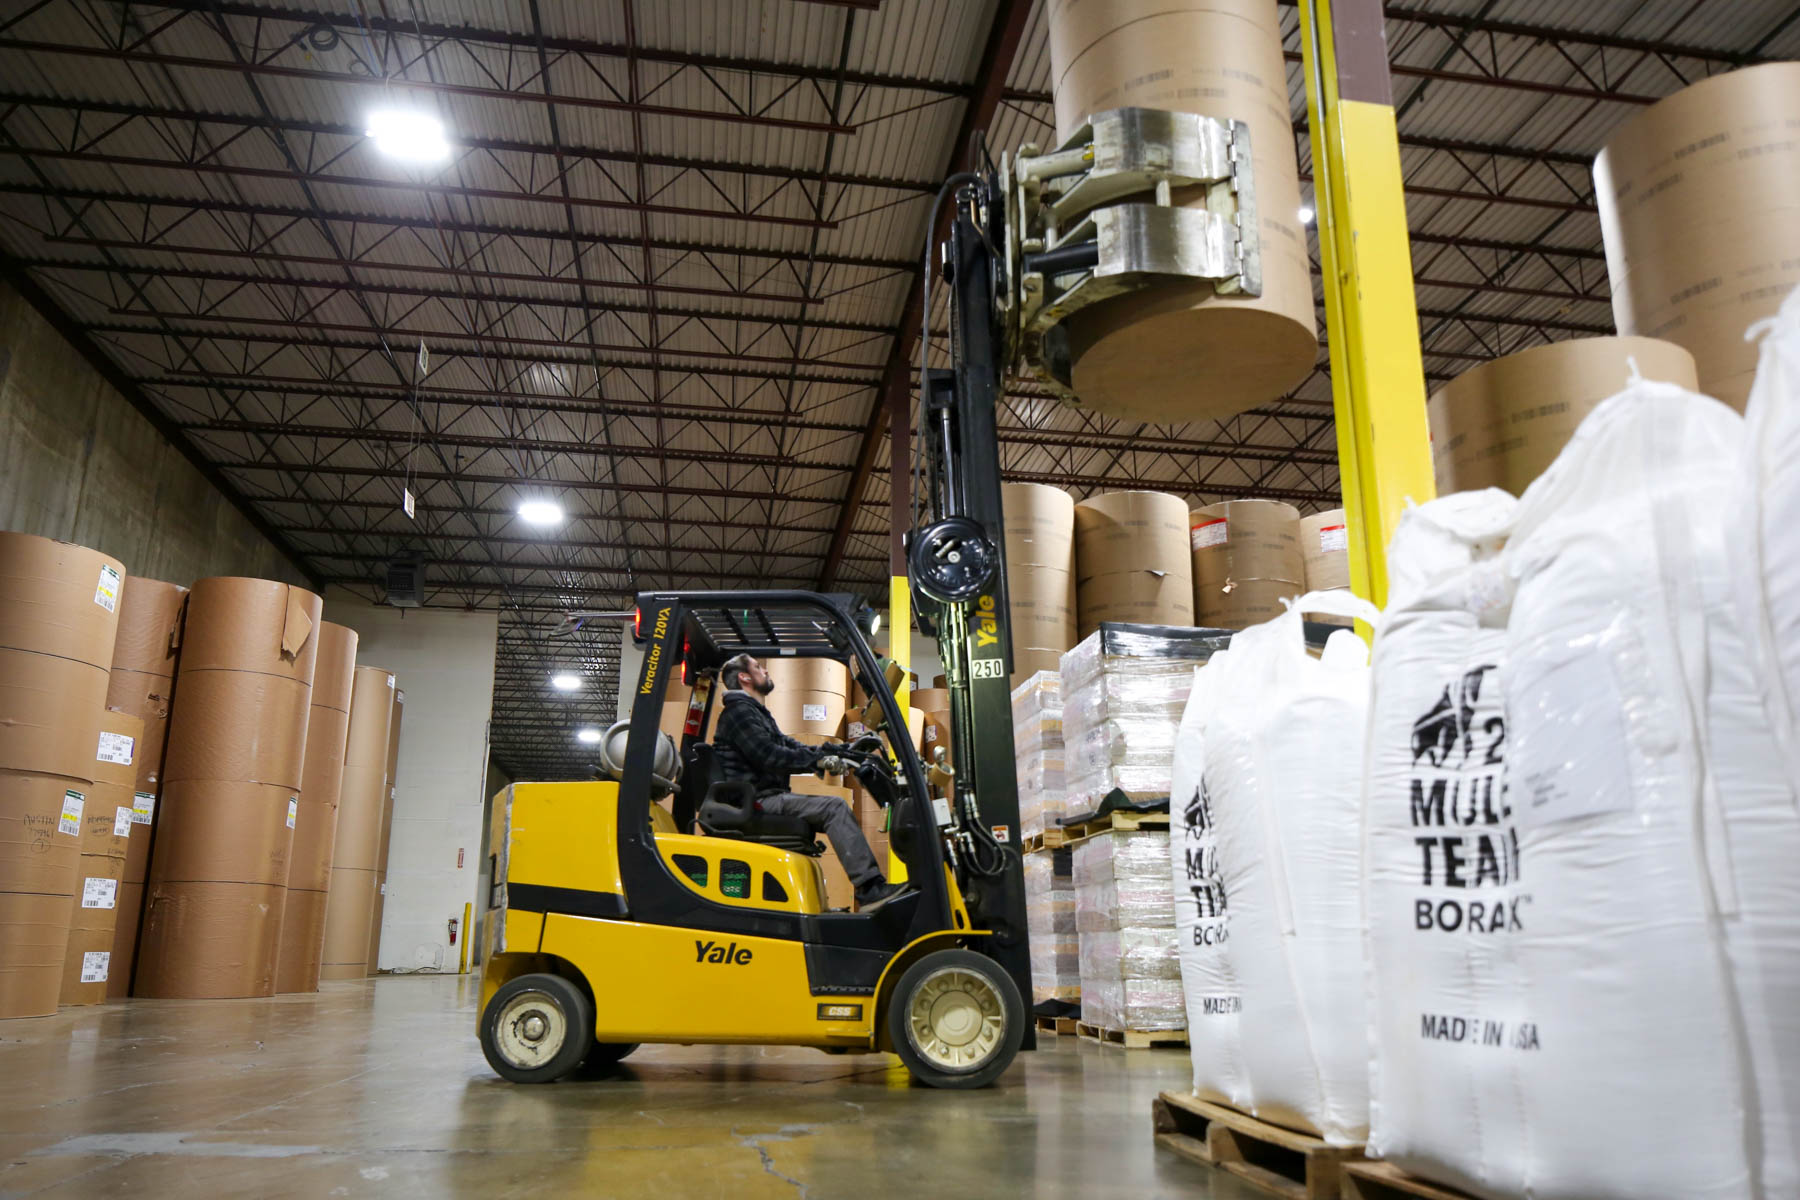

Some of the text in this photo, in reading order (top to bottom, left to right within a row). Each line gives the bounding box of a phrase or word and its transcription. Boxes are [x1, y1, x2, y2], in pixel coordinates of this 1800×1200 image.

[976, 595, 998, 647] Yale
[640, 607, 672, 694] Veracitor 120VX
[974, 660, 1001, 677] 250
[696, 940, 753, 966] Yale
[1483, 1020, 1504, 1047] IN
